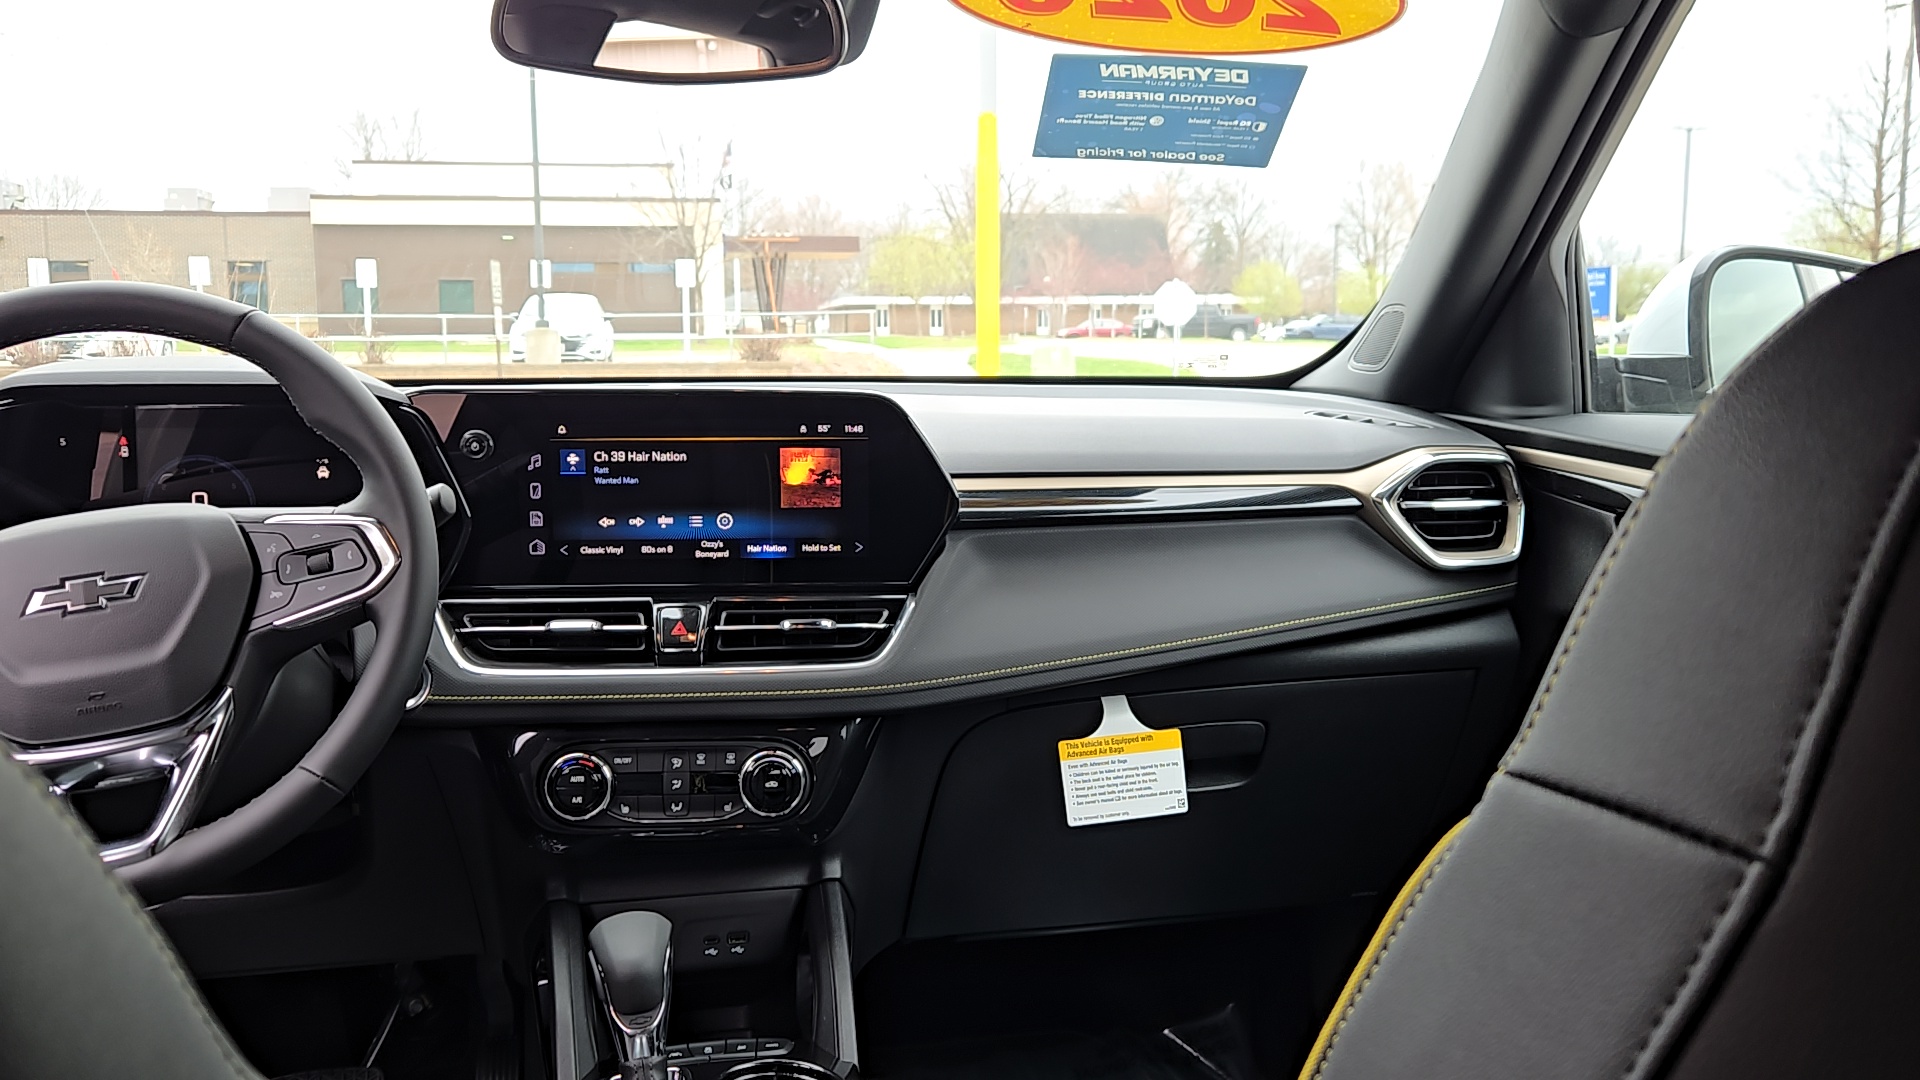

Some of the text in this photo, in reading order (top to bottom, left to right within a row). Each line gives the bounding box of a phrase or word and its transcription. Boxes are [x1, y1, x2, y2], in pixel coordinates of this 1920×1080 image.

[594, 451, 687, 462] Ch 39 Hair Nation
[594, 466, 609, 474] Ratt
[580, 546, 623, 555] Classic Vinyl
[667, 545, 673, 553] 8
[747, 545, 787, 553] Hair Nation
[802, 544, 841, 552] Hold to Set
[695, 550, 729, 559] Boneyard
[1081, 740, 1102, 748] Vehicle
[1111, 736, 1139, 746] Equipped
[1067, 749, 1097, 758] Advanced
